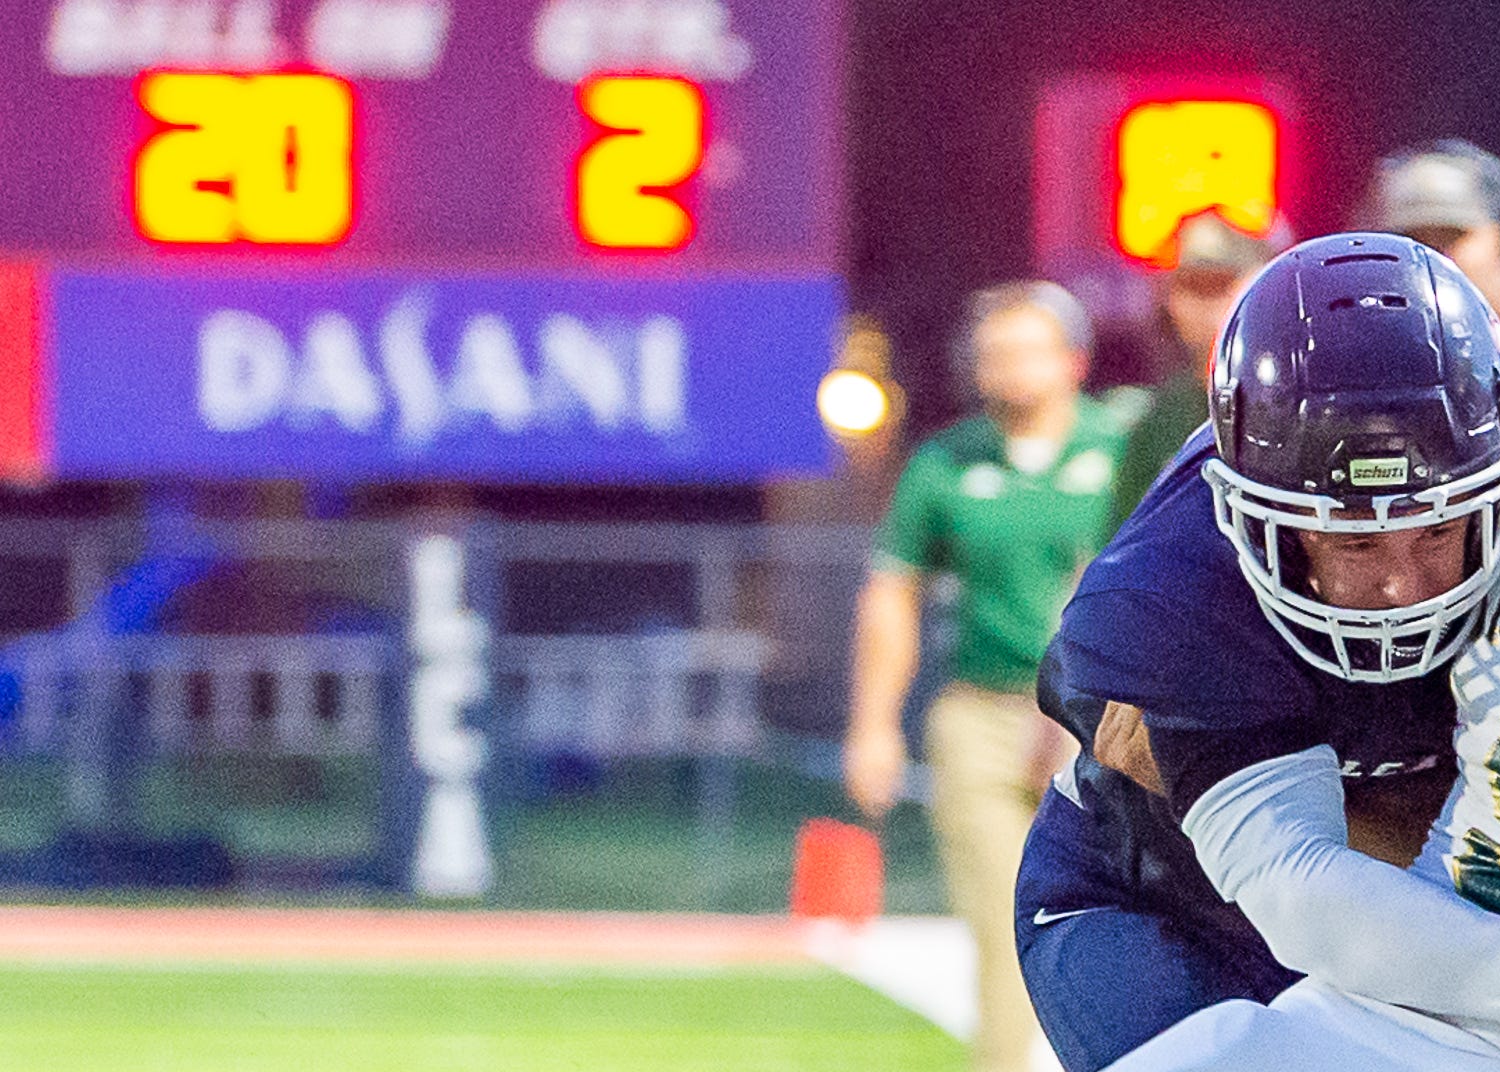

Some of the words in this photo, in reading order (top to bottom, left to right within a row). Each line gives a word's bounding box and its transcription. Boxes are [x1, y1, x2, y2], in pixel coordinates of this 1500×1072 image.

[134, 71, 355, 245] 20
[575, 72, 706, 250] 2
[199, 287, 689, 452] DASANI
